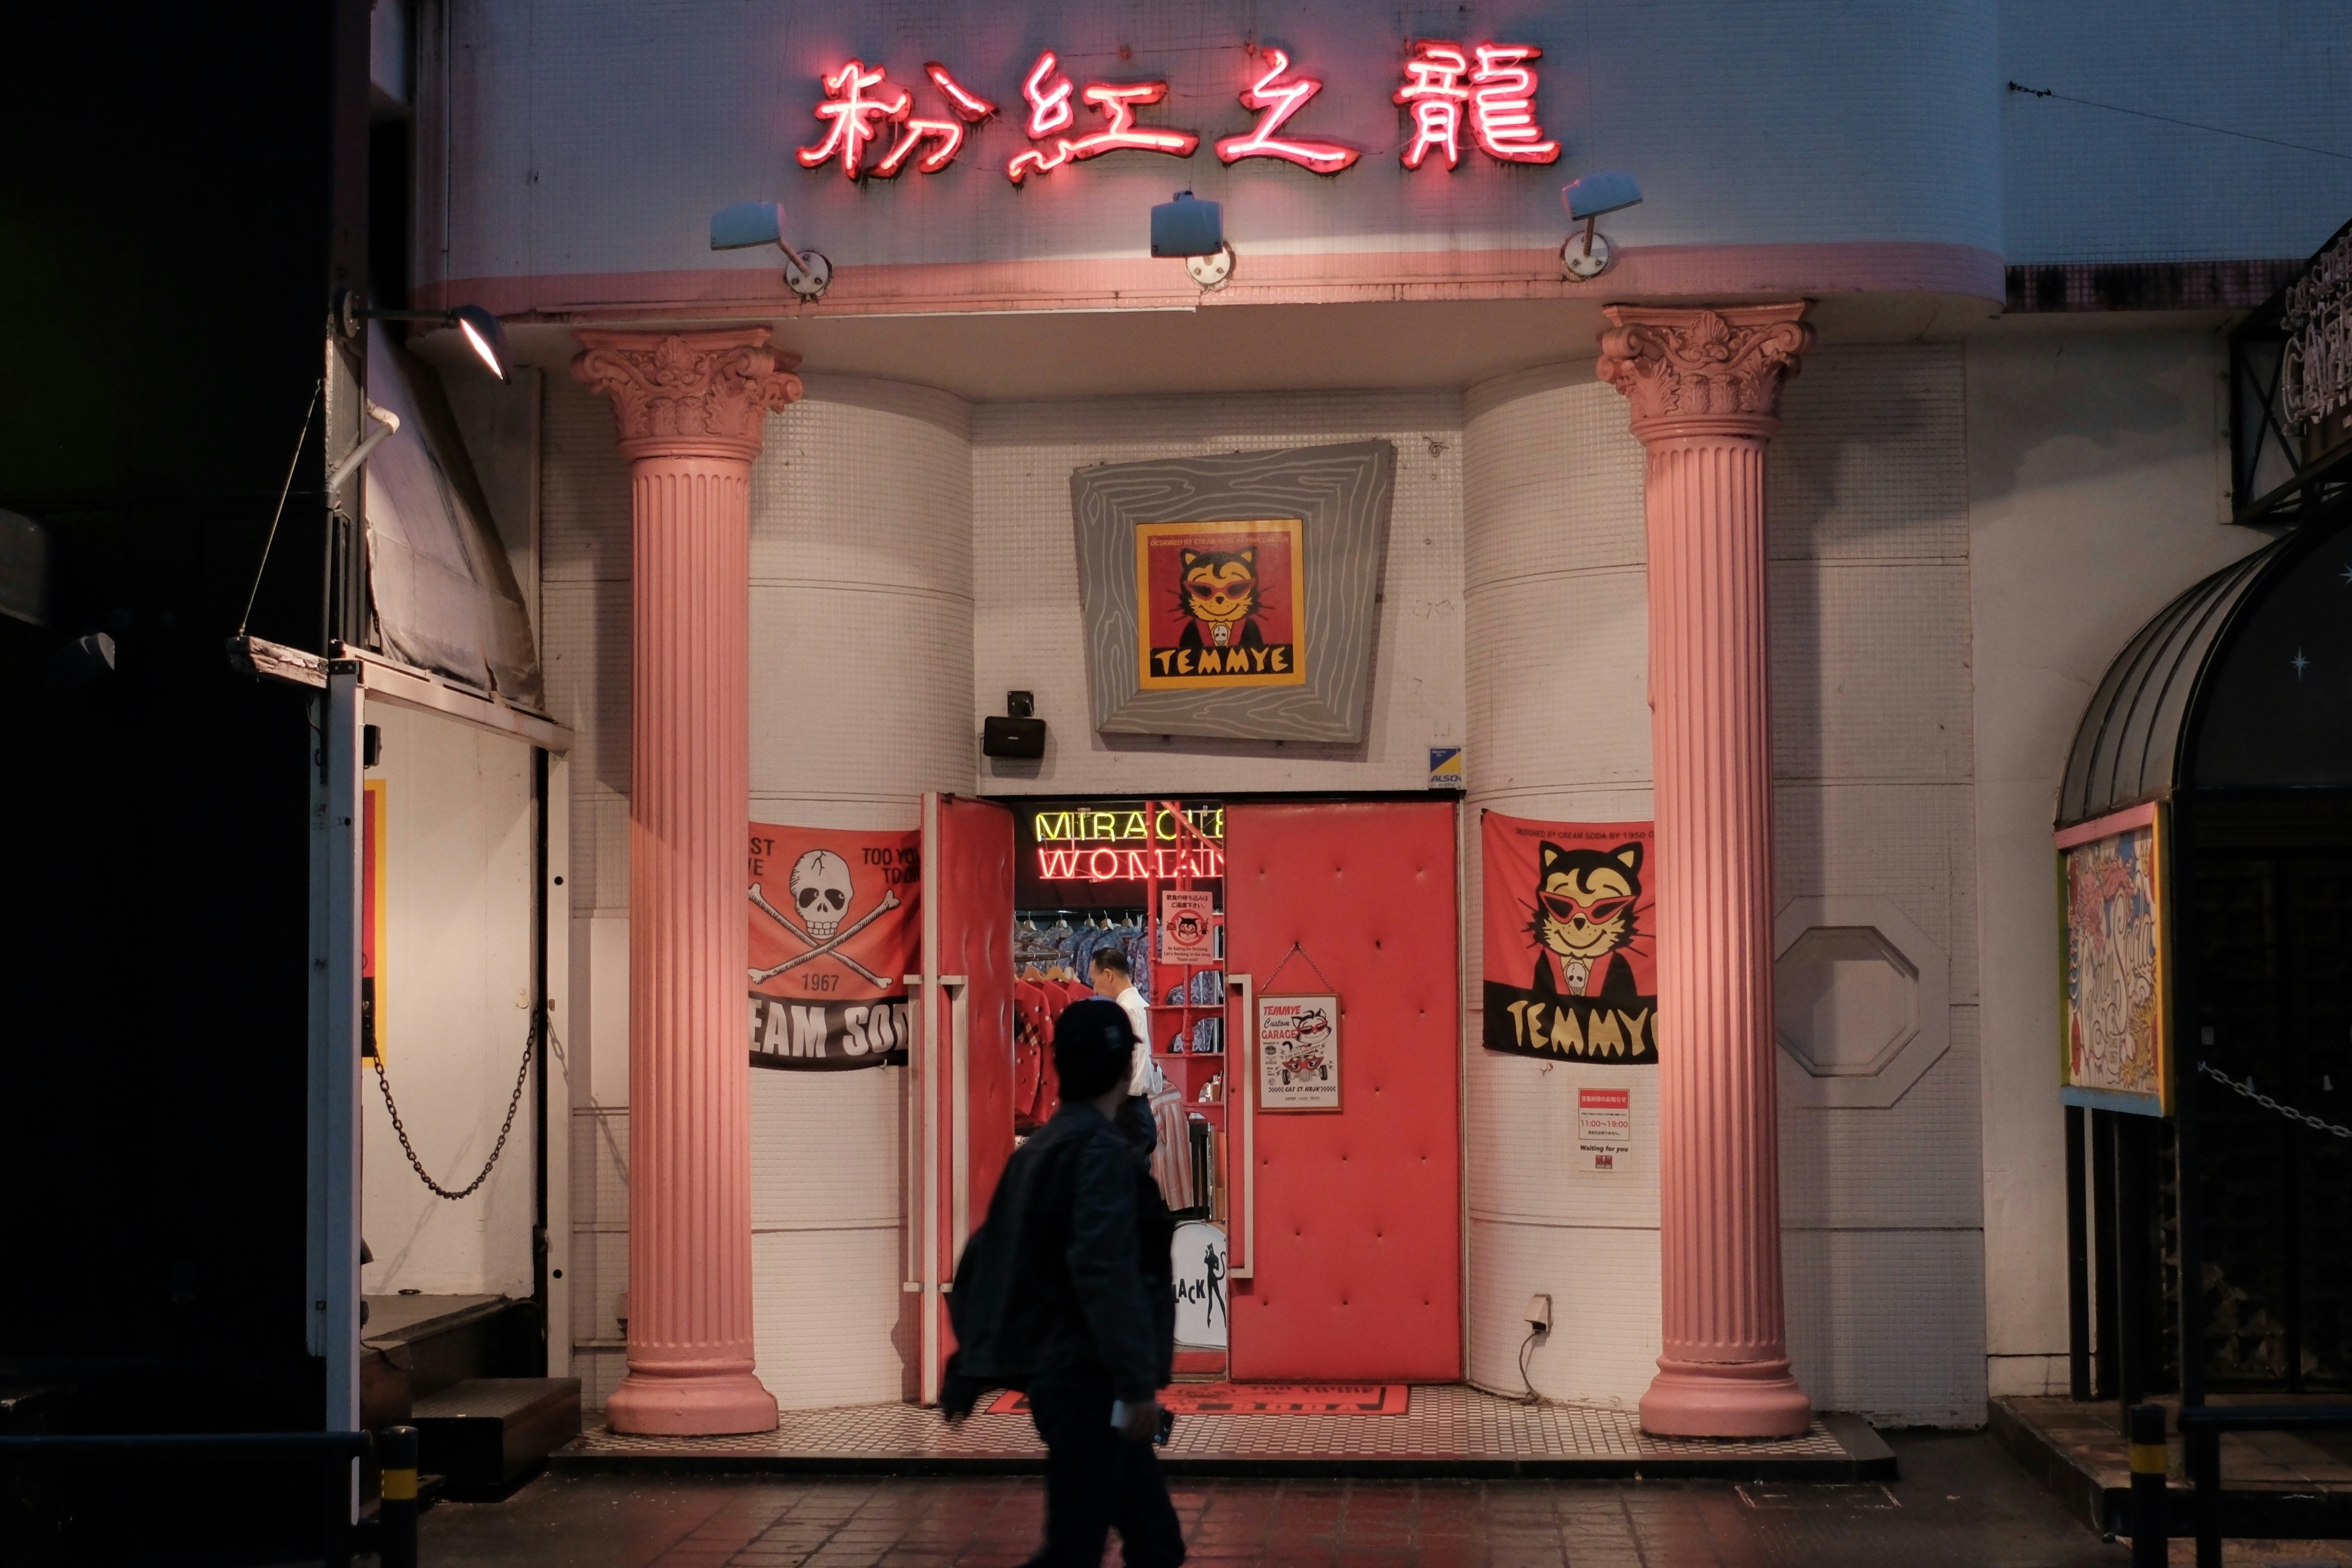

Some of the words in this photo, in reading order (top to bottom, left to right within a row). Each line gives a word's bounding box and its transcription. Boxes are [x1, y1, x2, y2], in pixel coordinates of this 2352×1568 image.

[796, 40, 1562, 184] 粉紅之龍
[1155, 647, 1289, 675] TEMMYE
[1516, 828, 1545, 837] DESIGNED
[862, 848, 892, 865] TOO
[802, 974, 839, 992] 1967
[1263, 1005, 1301, 1016] TEMMYE
[1264, 1017, 1290, 1028] Custom
[1507, 1000, 1658, 1057] TEMMY
[1261, 1030, 1296, 1039] GARAGE
[1580, 1144, 1604, 1153] Waiting
[1616, 1146, 1629, 1154] you
